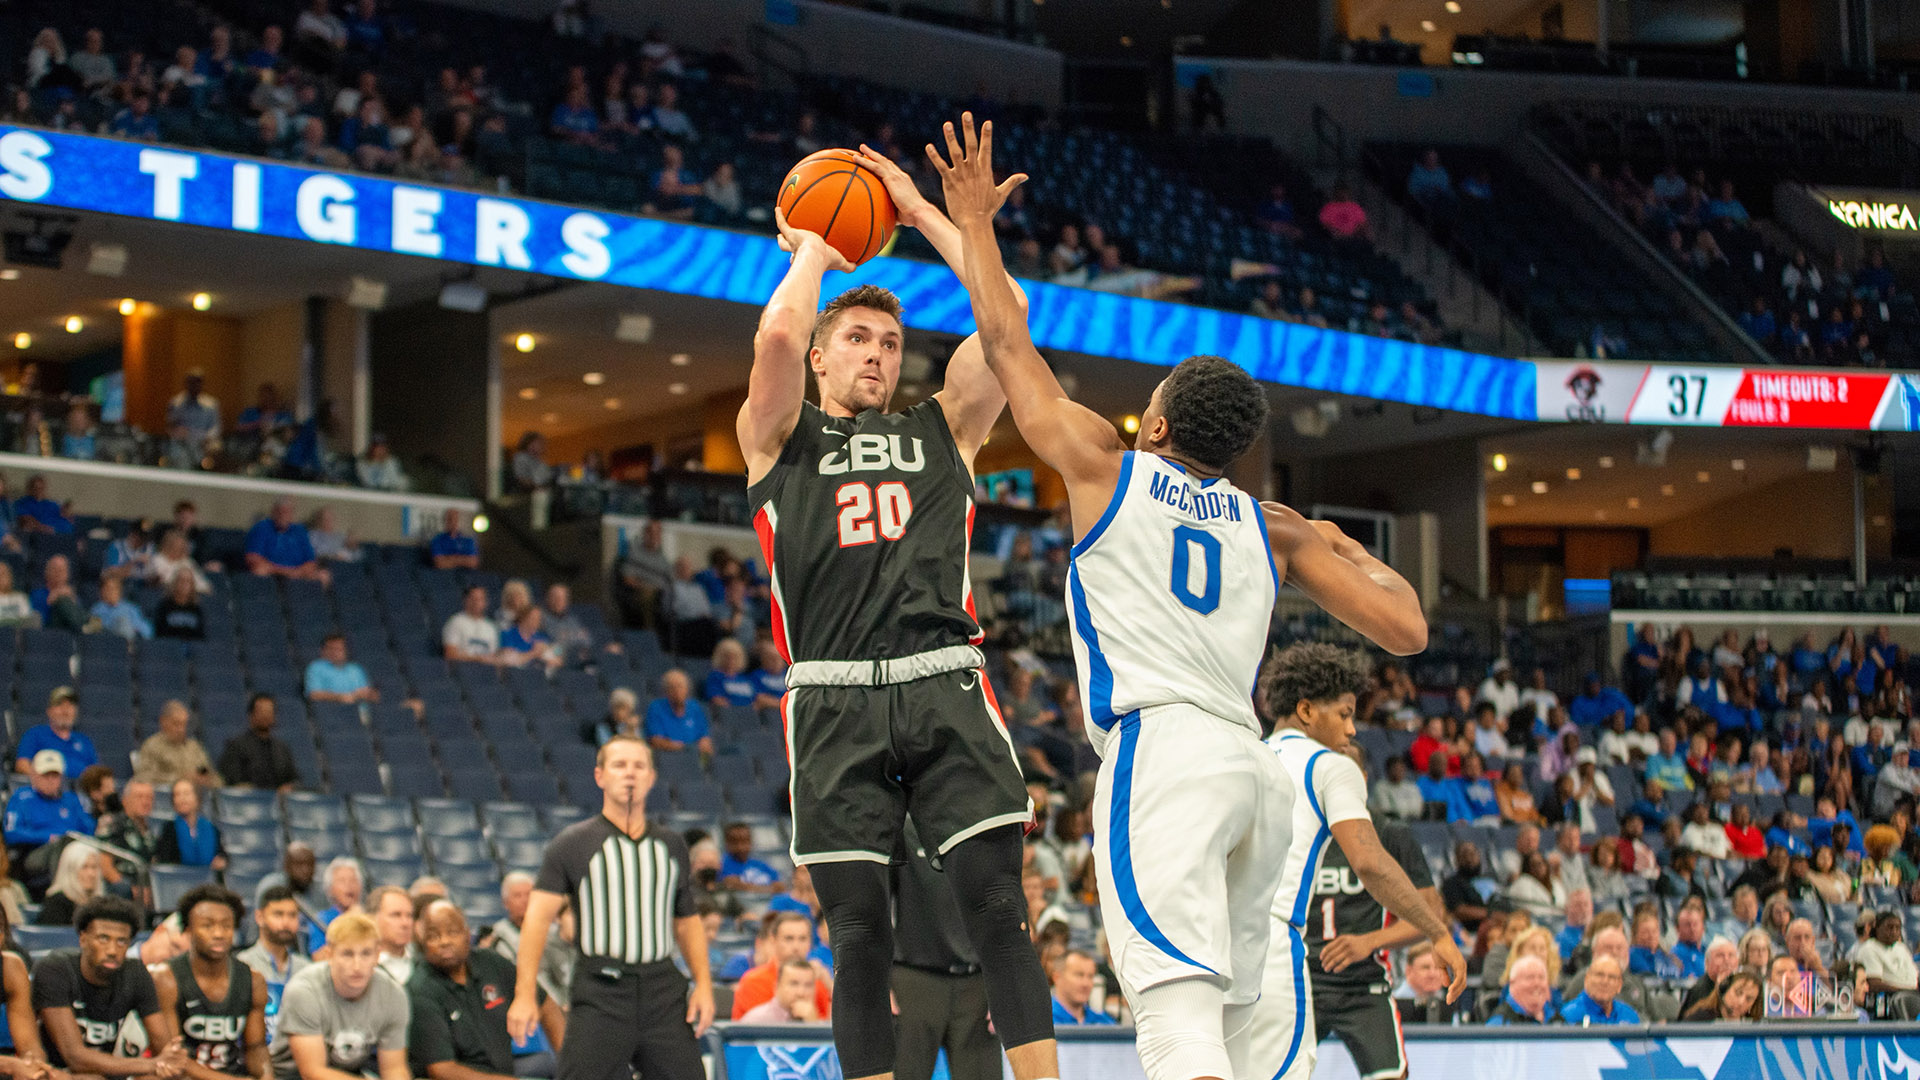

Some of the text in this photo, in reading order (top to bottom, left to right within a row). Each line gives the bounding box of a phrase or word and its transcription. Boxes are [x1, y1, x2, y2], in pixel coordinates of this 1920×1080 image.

[138, 148, 613, 280] TIGERS
[1667, 373, 1708, 417] 37
[818, 433, 926, 476] CBU
[835, 481, 914, 548] 20
[1169, 523, 1223, 618] 0
[1316, 866, 1365, 895] BU
[1321, 898, 1337, 941] 1
[183, 1014, 246, 1041] CBU
